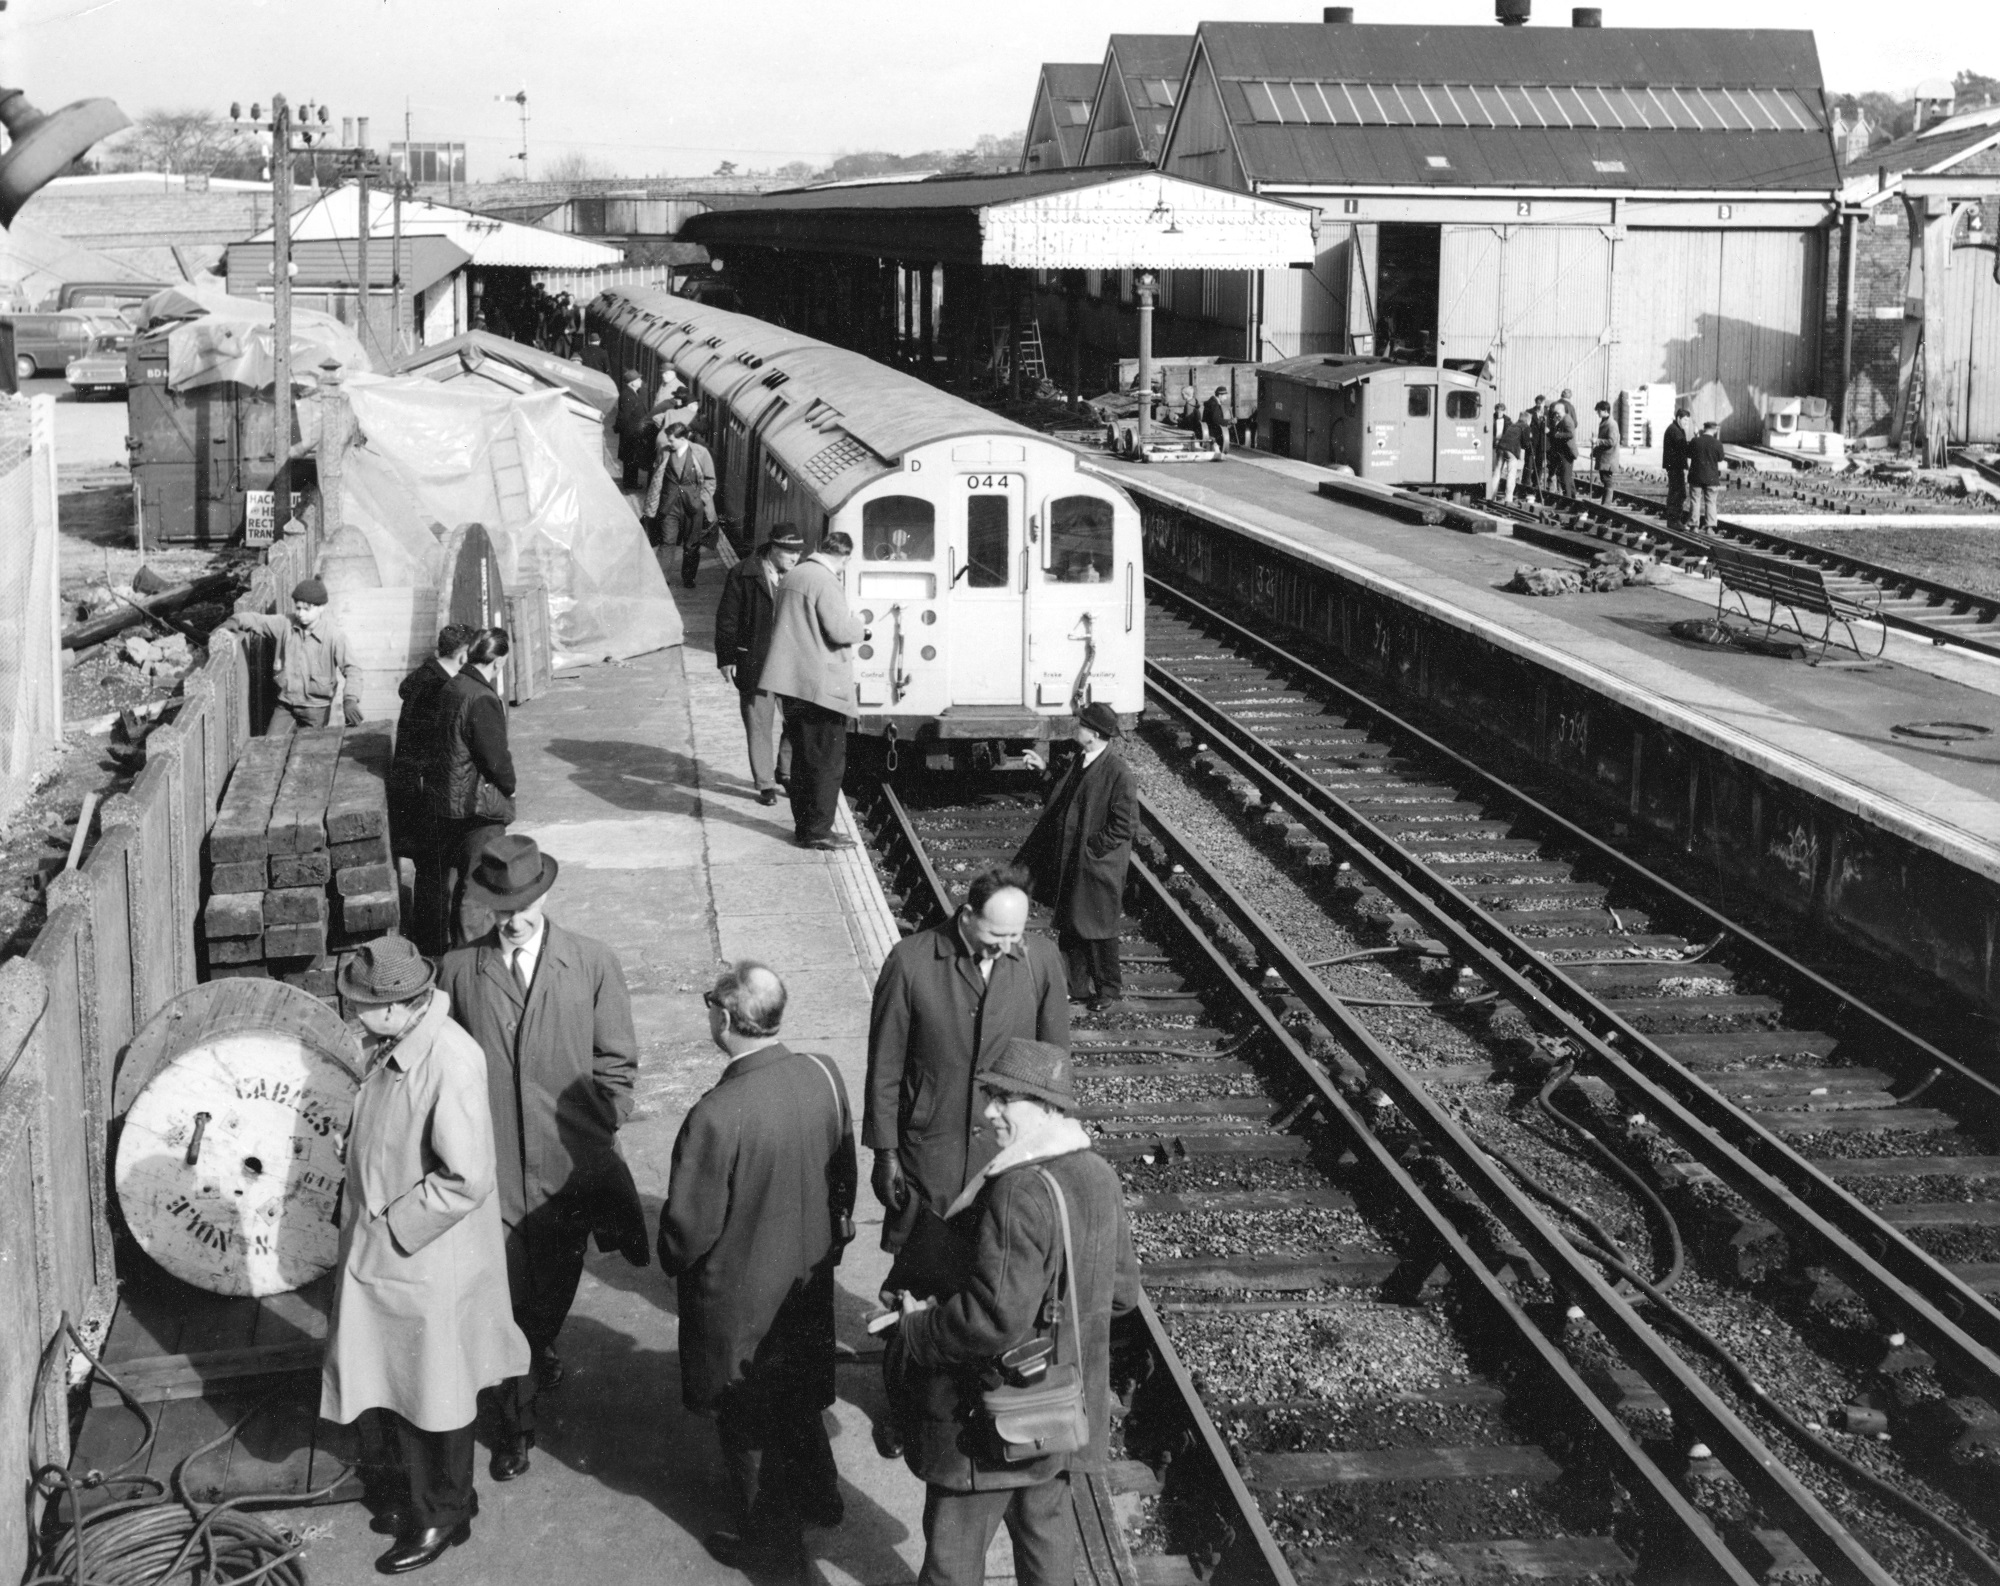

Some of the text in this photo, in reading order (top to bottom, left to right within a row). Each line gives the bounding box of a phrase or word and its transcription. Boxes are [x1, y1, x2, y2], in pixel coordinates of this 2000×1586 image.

[1519, 203, 1529, 216] 2
[1971, 216, 1982, 229] 4
[147, 369, 162, 378] BD
[911, 460, 921, 472] D
[967, 475, 1009, 489] 044
